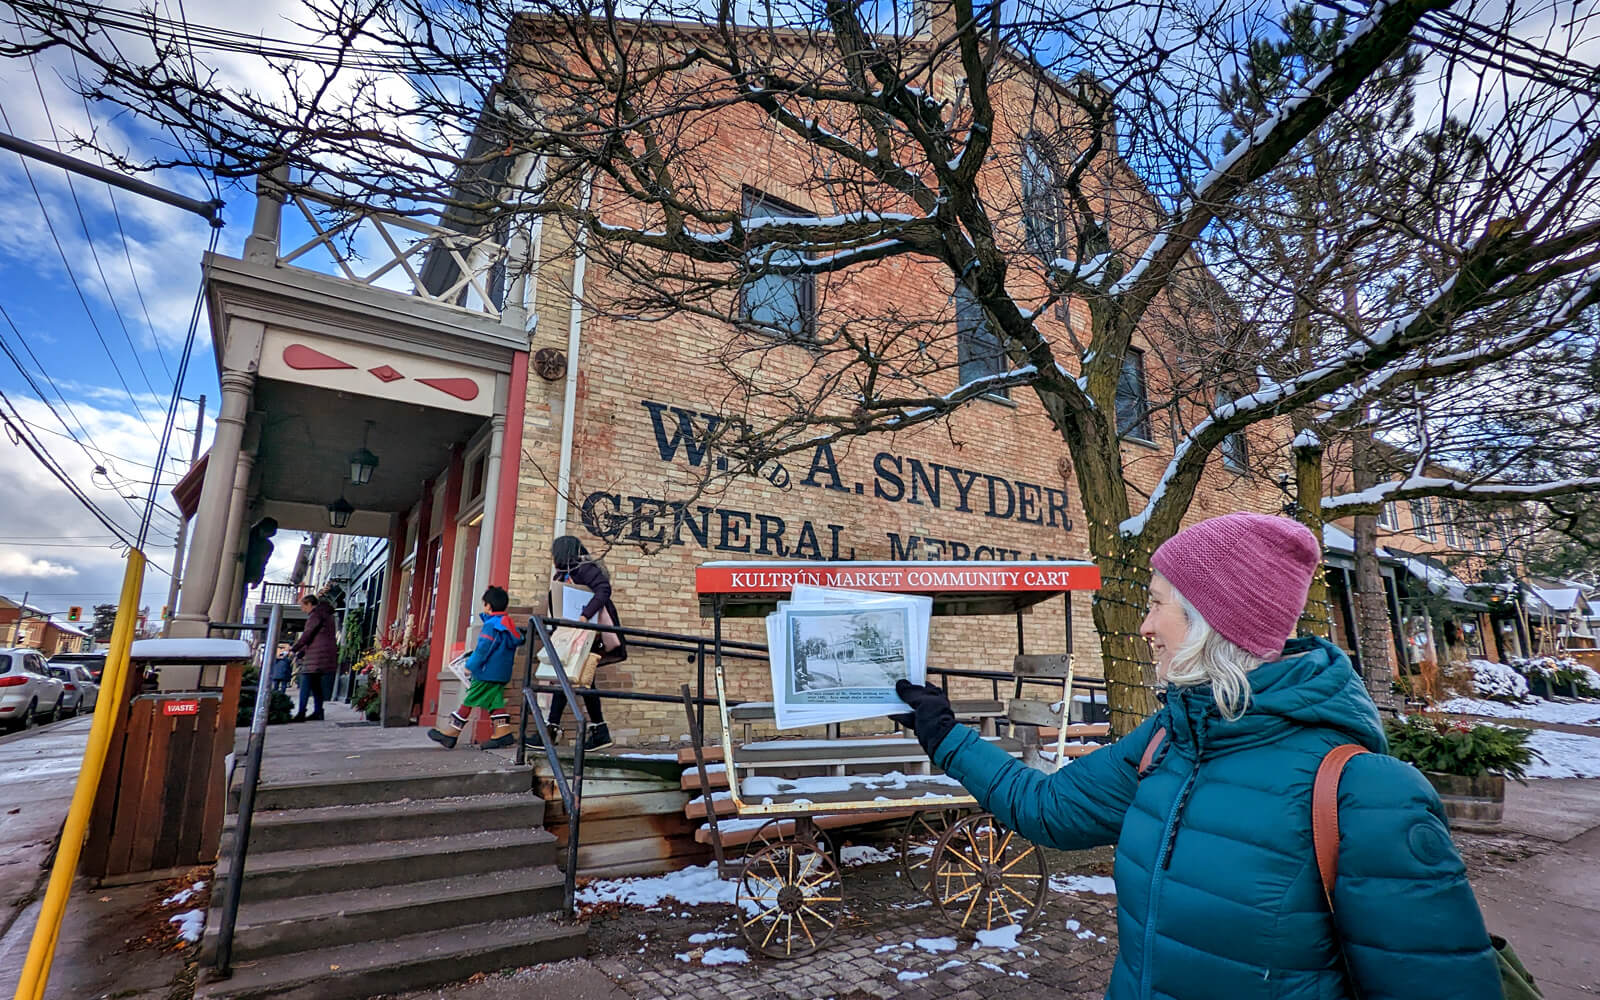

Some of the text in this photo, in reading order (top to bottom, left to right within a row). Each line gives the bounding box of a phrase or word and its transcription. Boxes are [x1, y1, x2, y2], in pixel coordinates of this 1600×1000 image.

[873, 452, 1073, 532] SNYDER
[581, 491, 855, 562] GENERAL
[731, 569, 1069, 588] KULTRÚN MARKET COMMUNITY CART
[167, 704, 195, 712] WASTE
